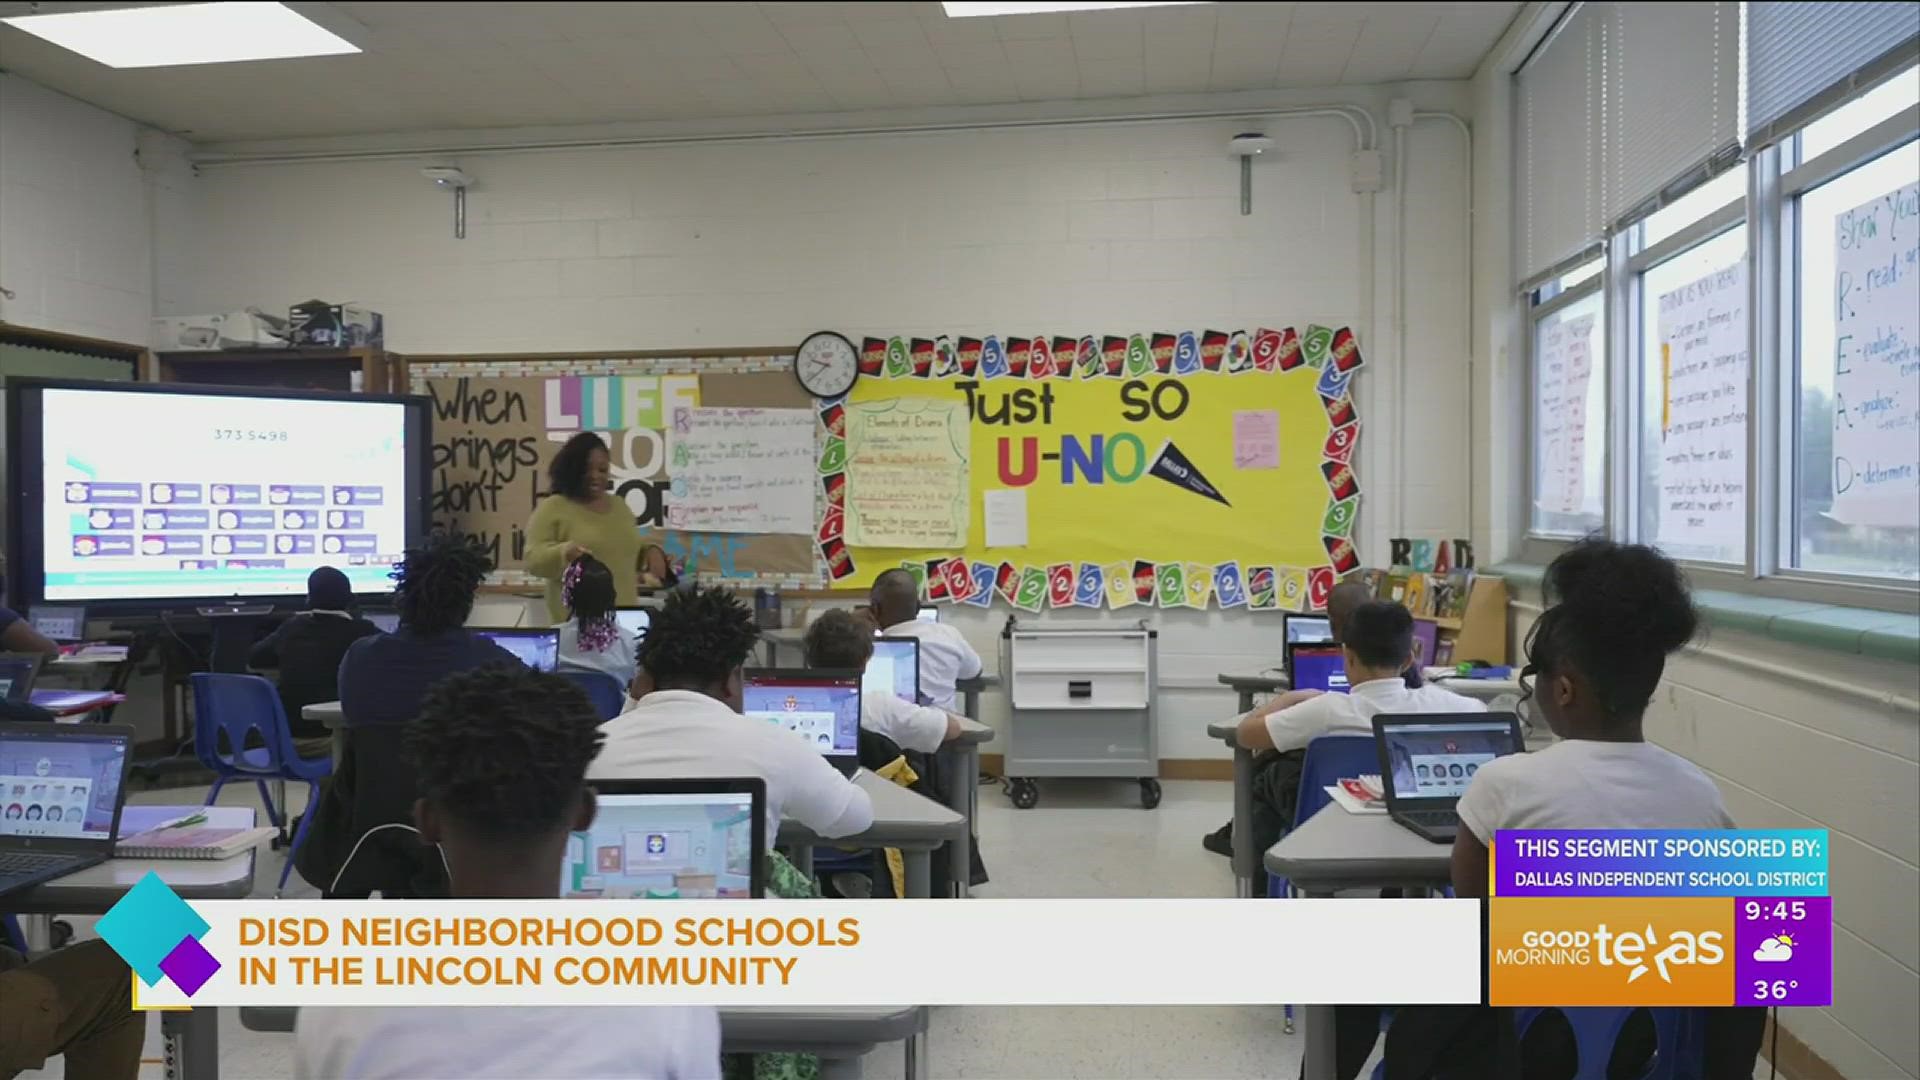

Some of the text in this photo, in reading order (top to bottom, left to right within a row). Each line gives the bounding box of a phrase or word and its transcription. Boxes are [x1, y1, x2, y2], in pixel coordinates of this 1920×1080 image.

[427, 377, 527, 426] When
[955, 379, 1190, 424] Just SO
[214, 429, 242, 441] 373
[1390, 538, 1475, 574] READ
